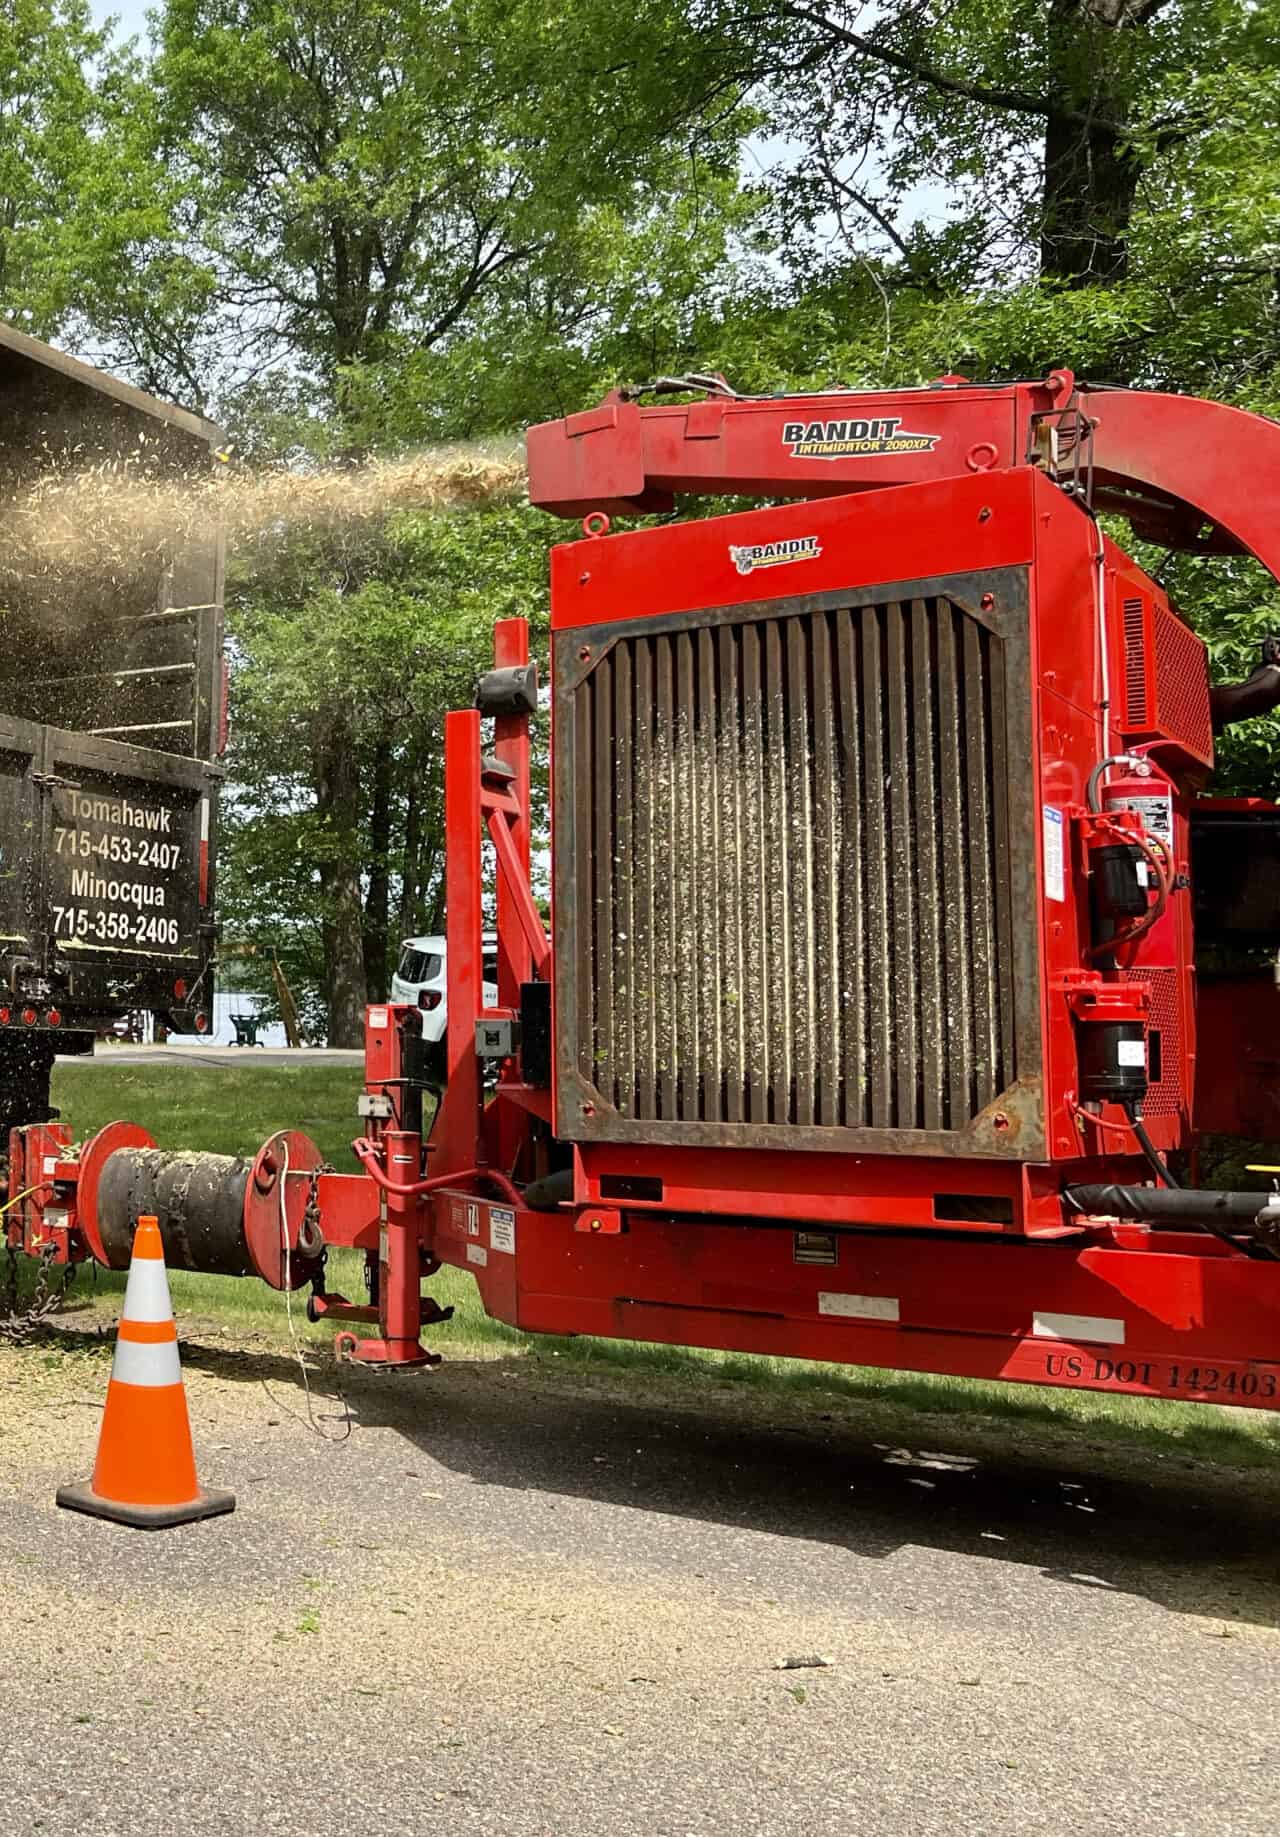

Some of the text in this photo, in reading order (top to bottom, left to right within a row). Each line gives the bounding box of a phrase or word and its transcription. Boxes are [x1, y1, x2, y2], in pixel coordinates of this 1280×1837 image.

[784, 419, 900, 442] BANDIT
[885, 438, 929, 451] 2090XP
[752, 537, 817, 558] BANDIT
[68, 790, 170, 832] Tomahawk
[55, 827, 180, 870] 715-453-2407
[71, 868, 165, 911] Minocqua
[53, 906, 179, 944] 715-358-2406
[1045, 1354, 1277, 1398] US DOT 142403
